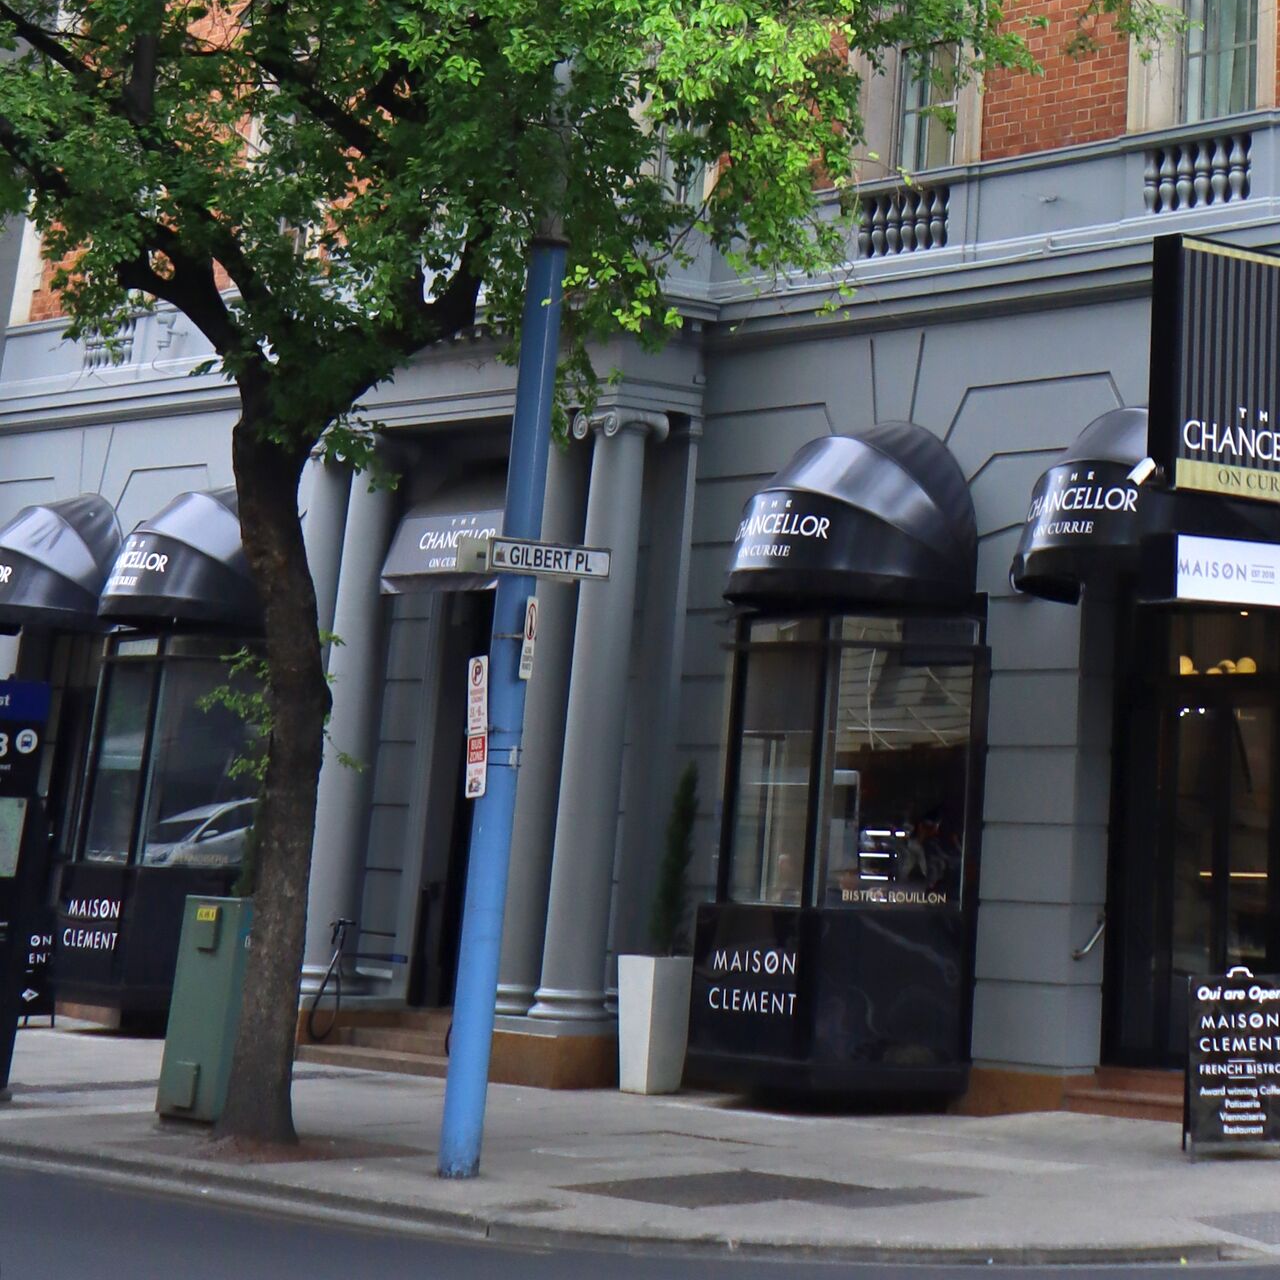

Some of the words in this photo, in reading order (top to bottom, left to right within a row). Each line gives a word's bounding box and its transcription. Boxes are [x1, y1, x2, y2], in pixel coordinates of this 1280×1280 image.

[1057, 470, 1095, 483] THE
[1217, 467, 1243, 487] ON
[1027, 486, 1139, 522] CHANCELLOR
[735, 512, 831, 543] CHANCELLOR
[1047, 520, 1094, 536] CURRIE
[509, 545, 572, 570] GILBERT
[574, 552, 593, 572] PL
[750, 544, 791, 557] CURRIE
[440, 556, 457, 568] CUR
[469, 750, 484, 762] ZONE
[62, 927, 119, 951] CLEMENT
[708, 986, 798, 1016] CLEMENT
[1197, 985, 1222, 1001] Oui
[1223, 989, 1246, 1001] are
[1199, 1063, 1243, 1075] FRENCH
[1199, 1085, 1226, 1096] Award
[1227, 1087, 1258, 1098] winning
[1223, 1124, 1264, 1134] Restaurant
